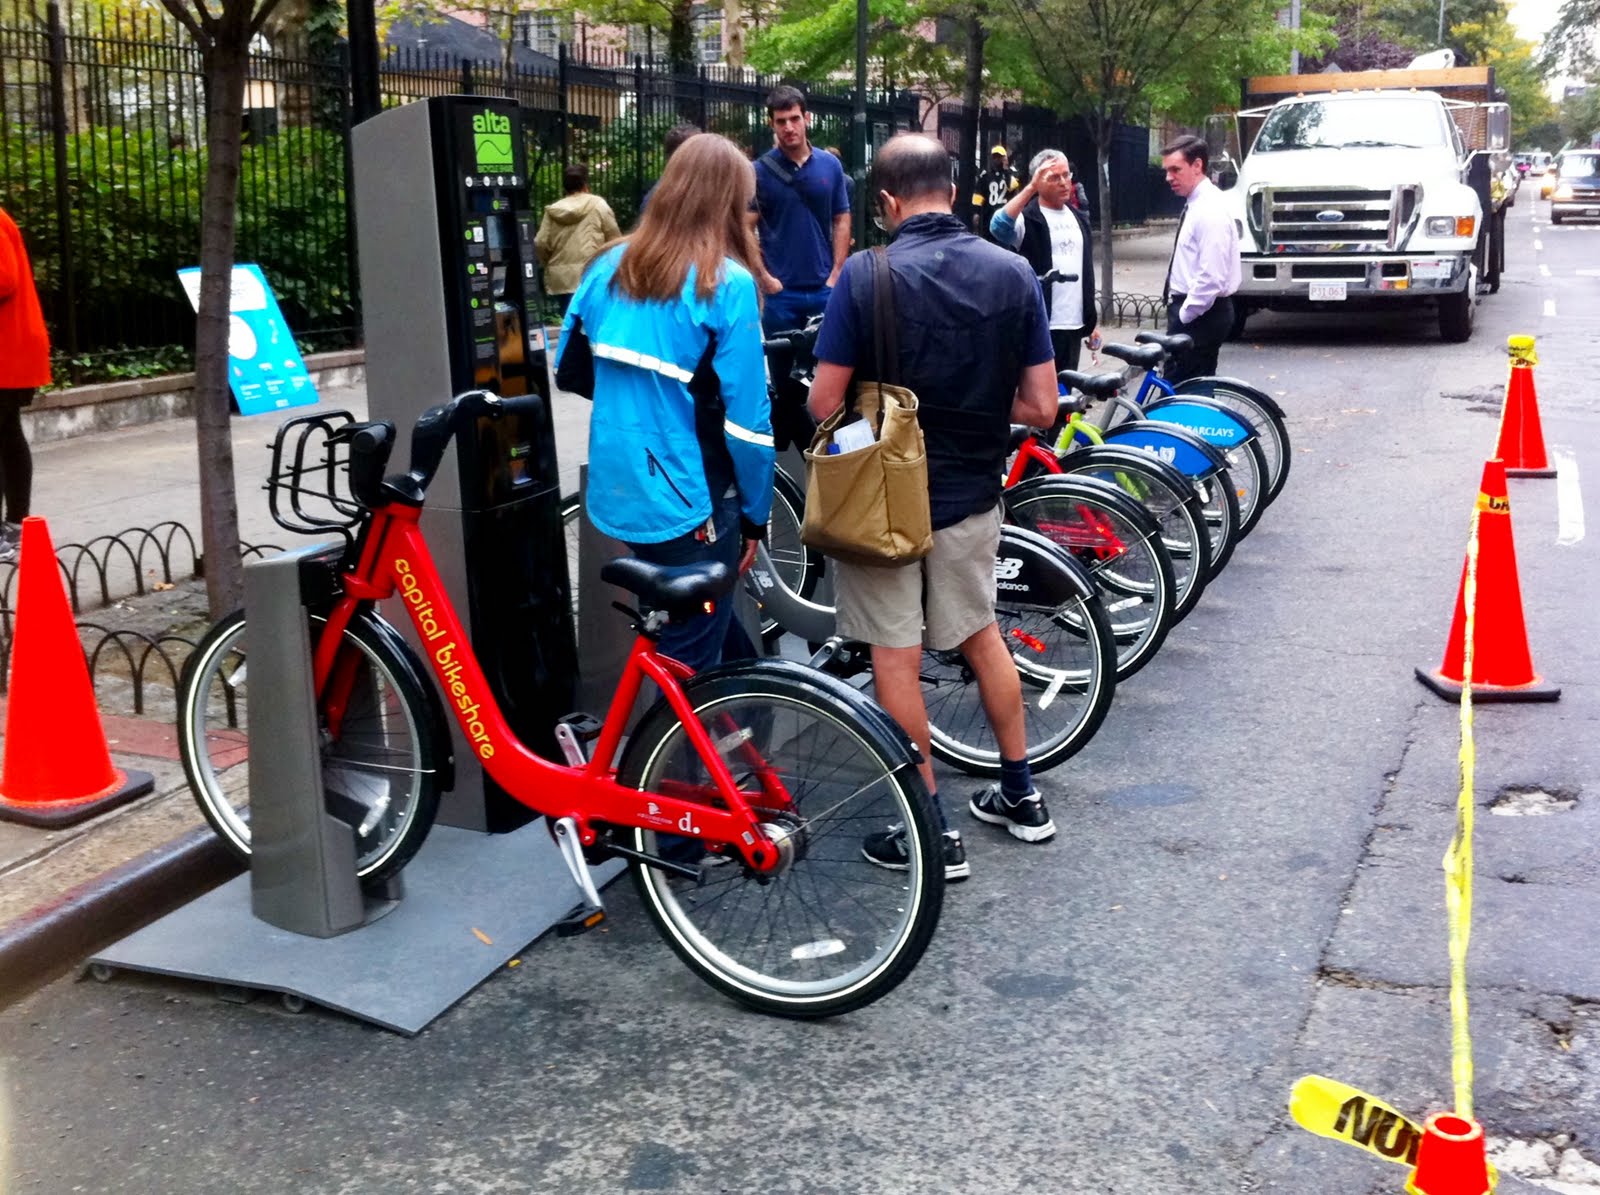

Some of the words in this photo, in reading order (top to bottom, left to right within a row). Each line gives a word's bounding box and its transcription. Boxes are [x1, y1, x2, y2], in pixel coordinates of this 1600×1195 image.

[473, 108, 510, 133] alta
[989, 180, 1007, 206] 82
[997, 581, 1029, 592] alance
[394, 558, 447, 641] capital
[436, 641, 495, 759] bikeshare
